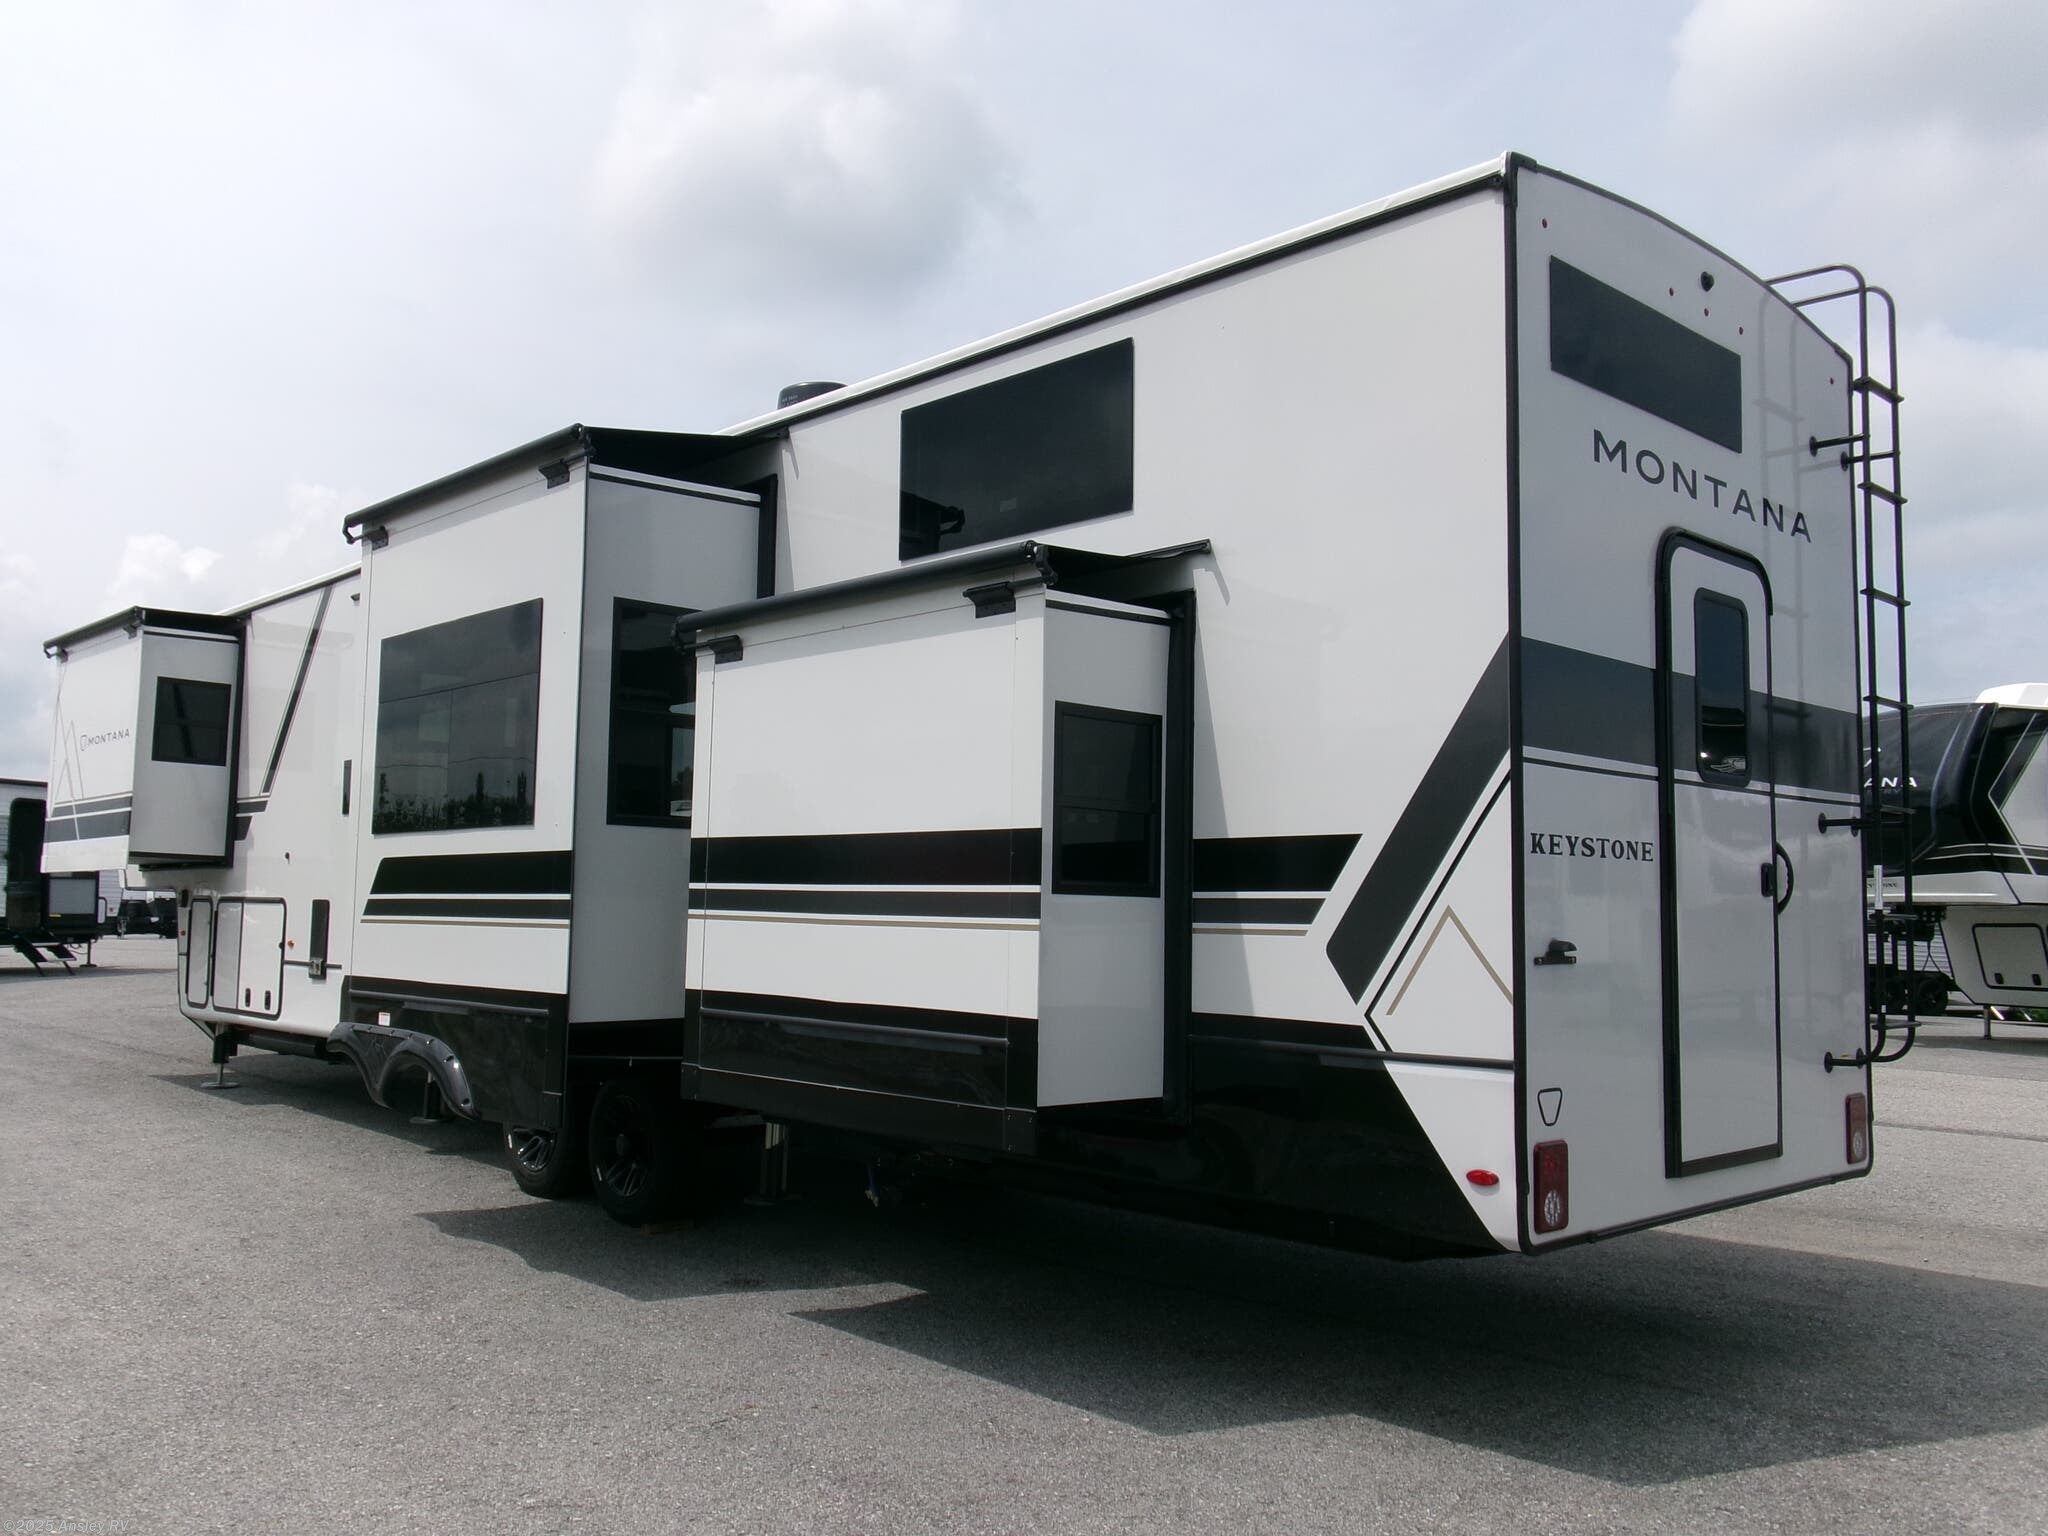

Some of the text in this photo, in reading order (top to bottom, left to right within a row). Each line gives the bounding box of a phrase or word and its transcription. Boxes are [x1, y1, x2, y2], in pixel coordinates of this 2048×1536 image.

[1593, 429, 1812, 543] MONTANA
[88, 728, 130, 745] MONTANA
[1530, 832, 1654, 862] KEYSTONE
